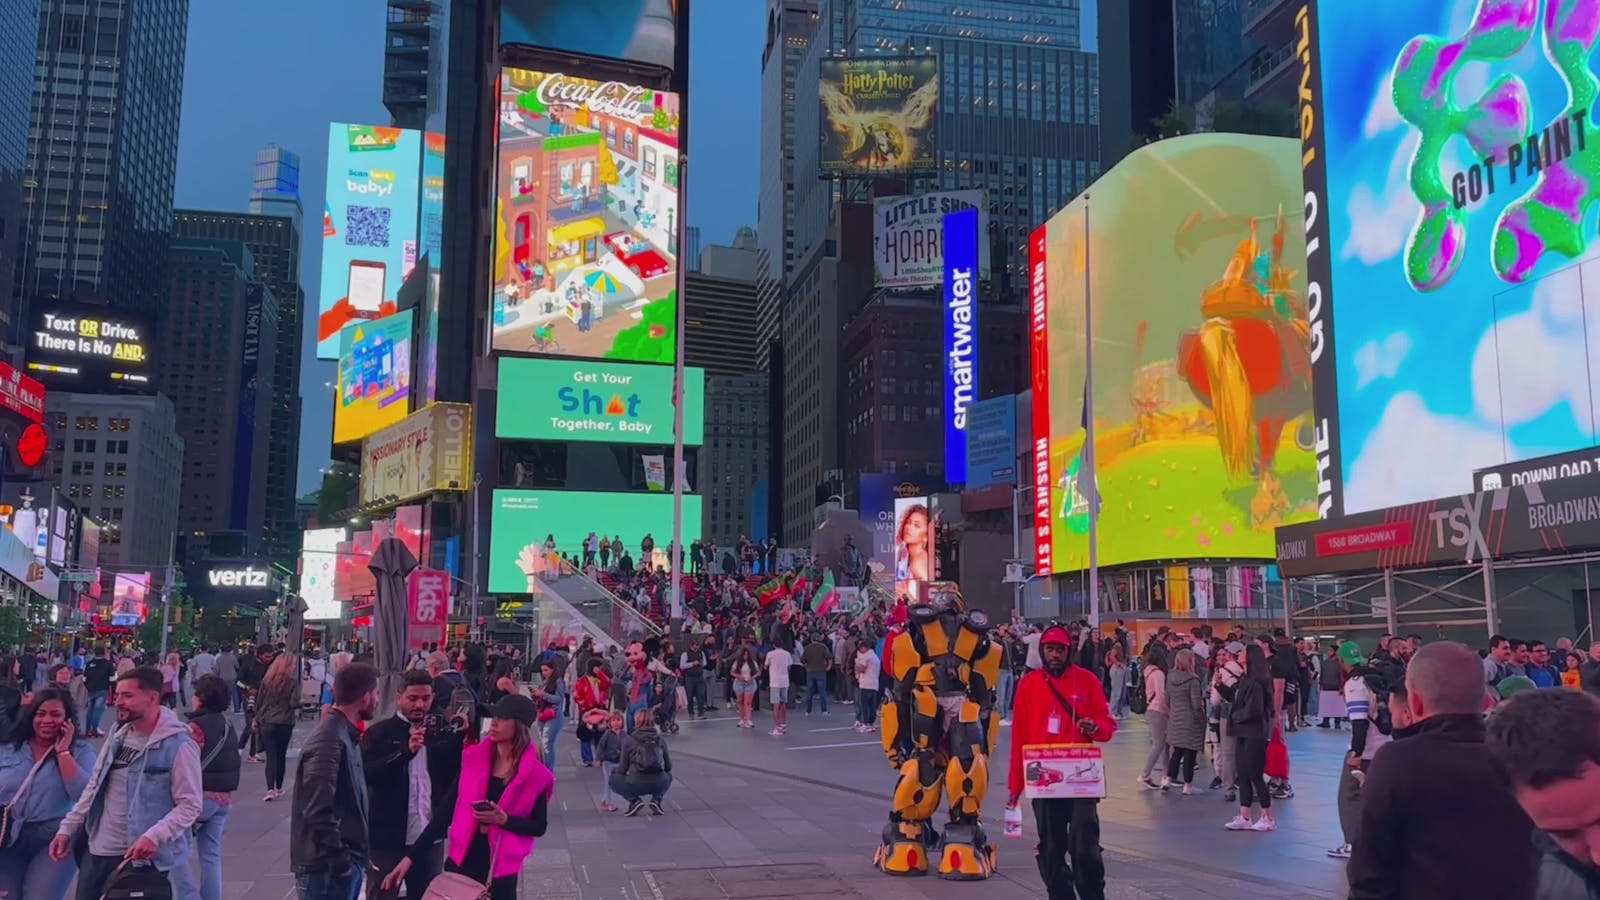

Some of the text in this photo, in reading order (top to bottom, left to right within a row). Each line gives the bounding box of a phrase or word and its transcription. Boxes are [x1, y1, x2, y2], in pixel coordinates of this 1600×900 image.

[537, 73, 646, 119] Coca-Cola
[844, 70, 916, 95] Harry Potter
[1452, 109, 1586, 210] GOT PAINT
[347, 180, 393, 197] baby!
[886, 197, 936, 228] LITTLE
[886, 228, 944, 276] HORR
[1033, 261, 1045, 332] INSIDE!
[44, 314, 139, 340] Text OR Drive.
[36, 332, 146, 362] There Is No AND.
[949, 267, 972, 429] smartwater
[573, 371, 632, 384] Get Your
[551, 417, 652, 434] Together, Baby
[1035, 437, 1049, 537] HERSHEY'S
[1347, 530, 1397, 546] BROADWAY
[1429, 490, 1600, 561] TSX BROADWAY
[208, 566, 267, 586] veriz
[416, 575, 443, 623] tkts
